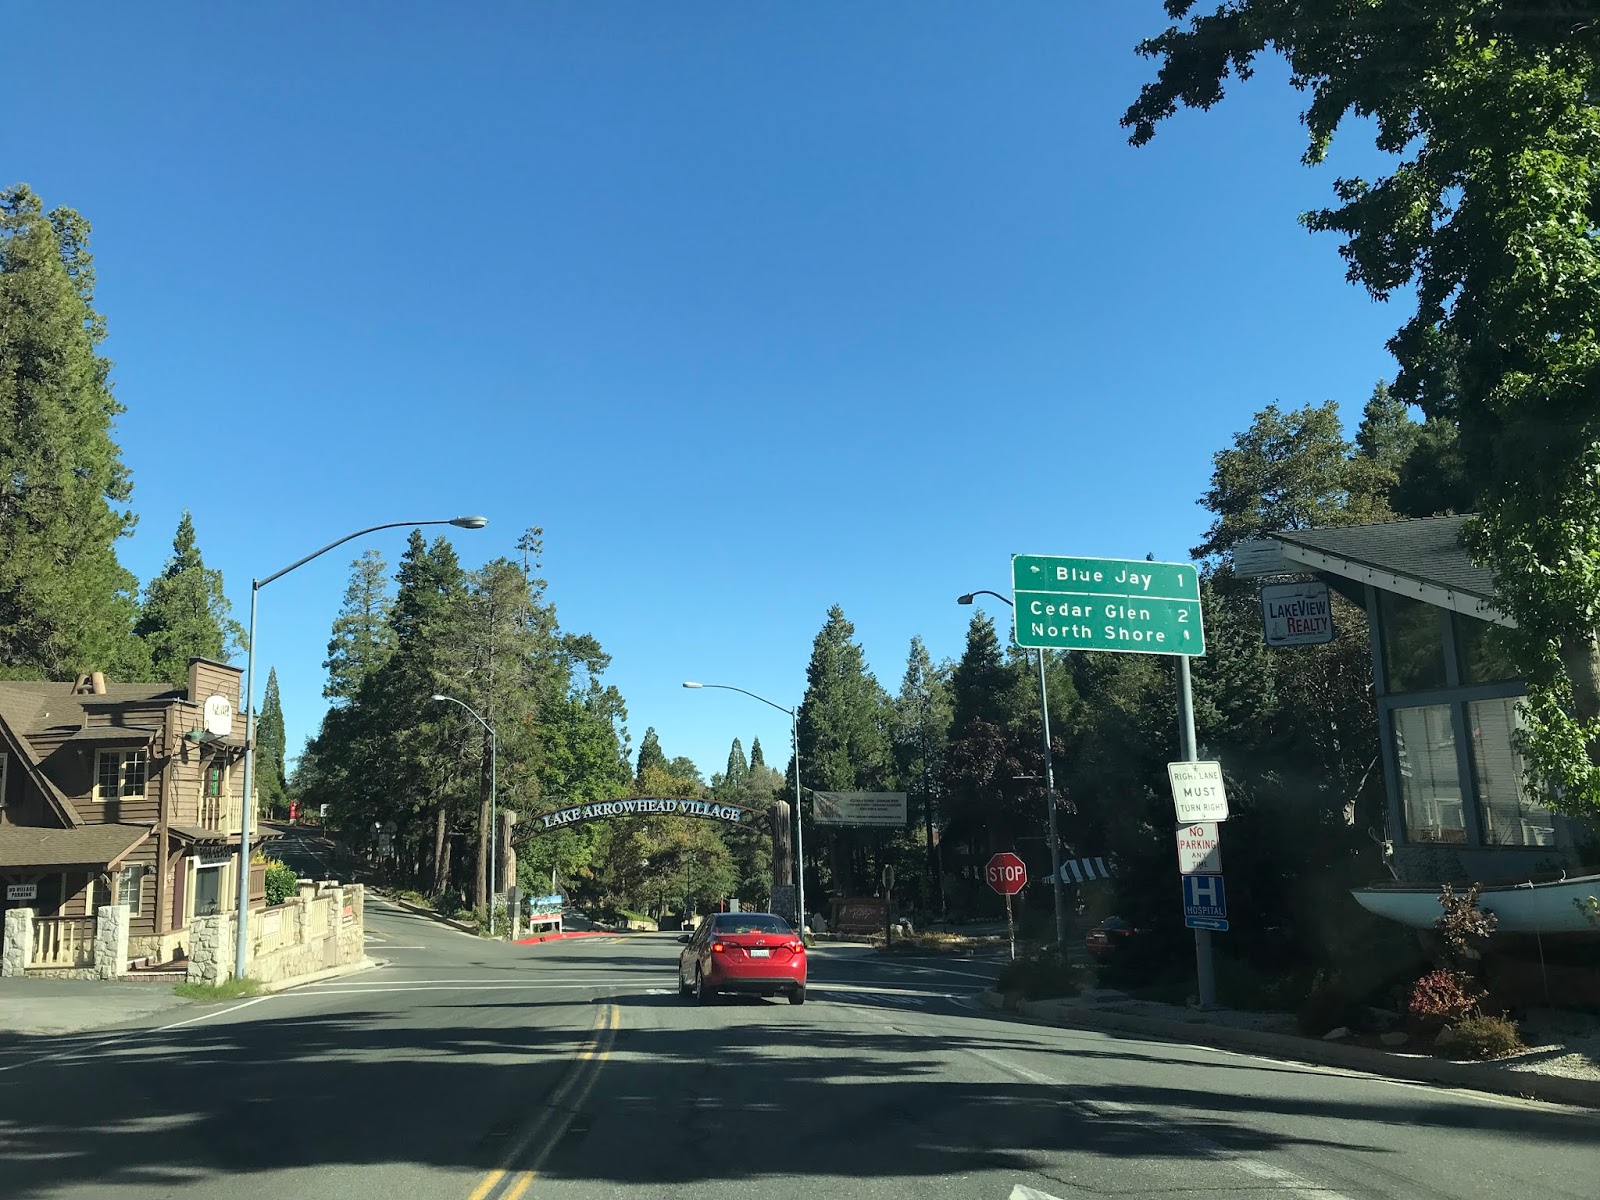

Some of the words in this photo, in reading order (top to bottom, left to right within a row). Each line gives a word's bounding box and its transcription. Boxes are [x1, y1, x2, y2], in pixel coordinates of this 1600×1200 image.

[1056, 566, 1103, 582] Blue
[1115, 570, 1152, 590] Jay
[1177, 573, 1183, 587] 1
[1030, 601, 1093, 617] Cedar
[1105, 604, 1150, 620] Glen
[1177, 609, 1189, 623] 2
[1031, 622, 1092, 639] North
[1104, 626, 1166, 642] Shore
[1199, 772, 1219, 780] LANE
[1183, 787, 1216, 797] MUST
[543, 808, 580, 829] LAKE
[584, 800, 676, 820] ARROWHEAD
[679, 800, 741, 823] VILLAGE
[1180, 804, 1202, 813] TURN
[1203, 803, 1224, 812] RIGHT
[1189, 826, 1204, 837] NO
[1180, 840, 1217, 850] PARKING
[990, 866, 1024, 882] STOP
[1190, 876, 1217, 906] H
[1187, 906, 1224, 916] HOSPITAL
